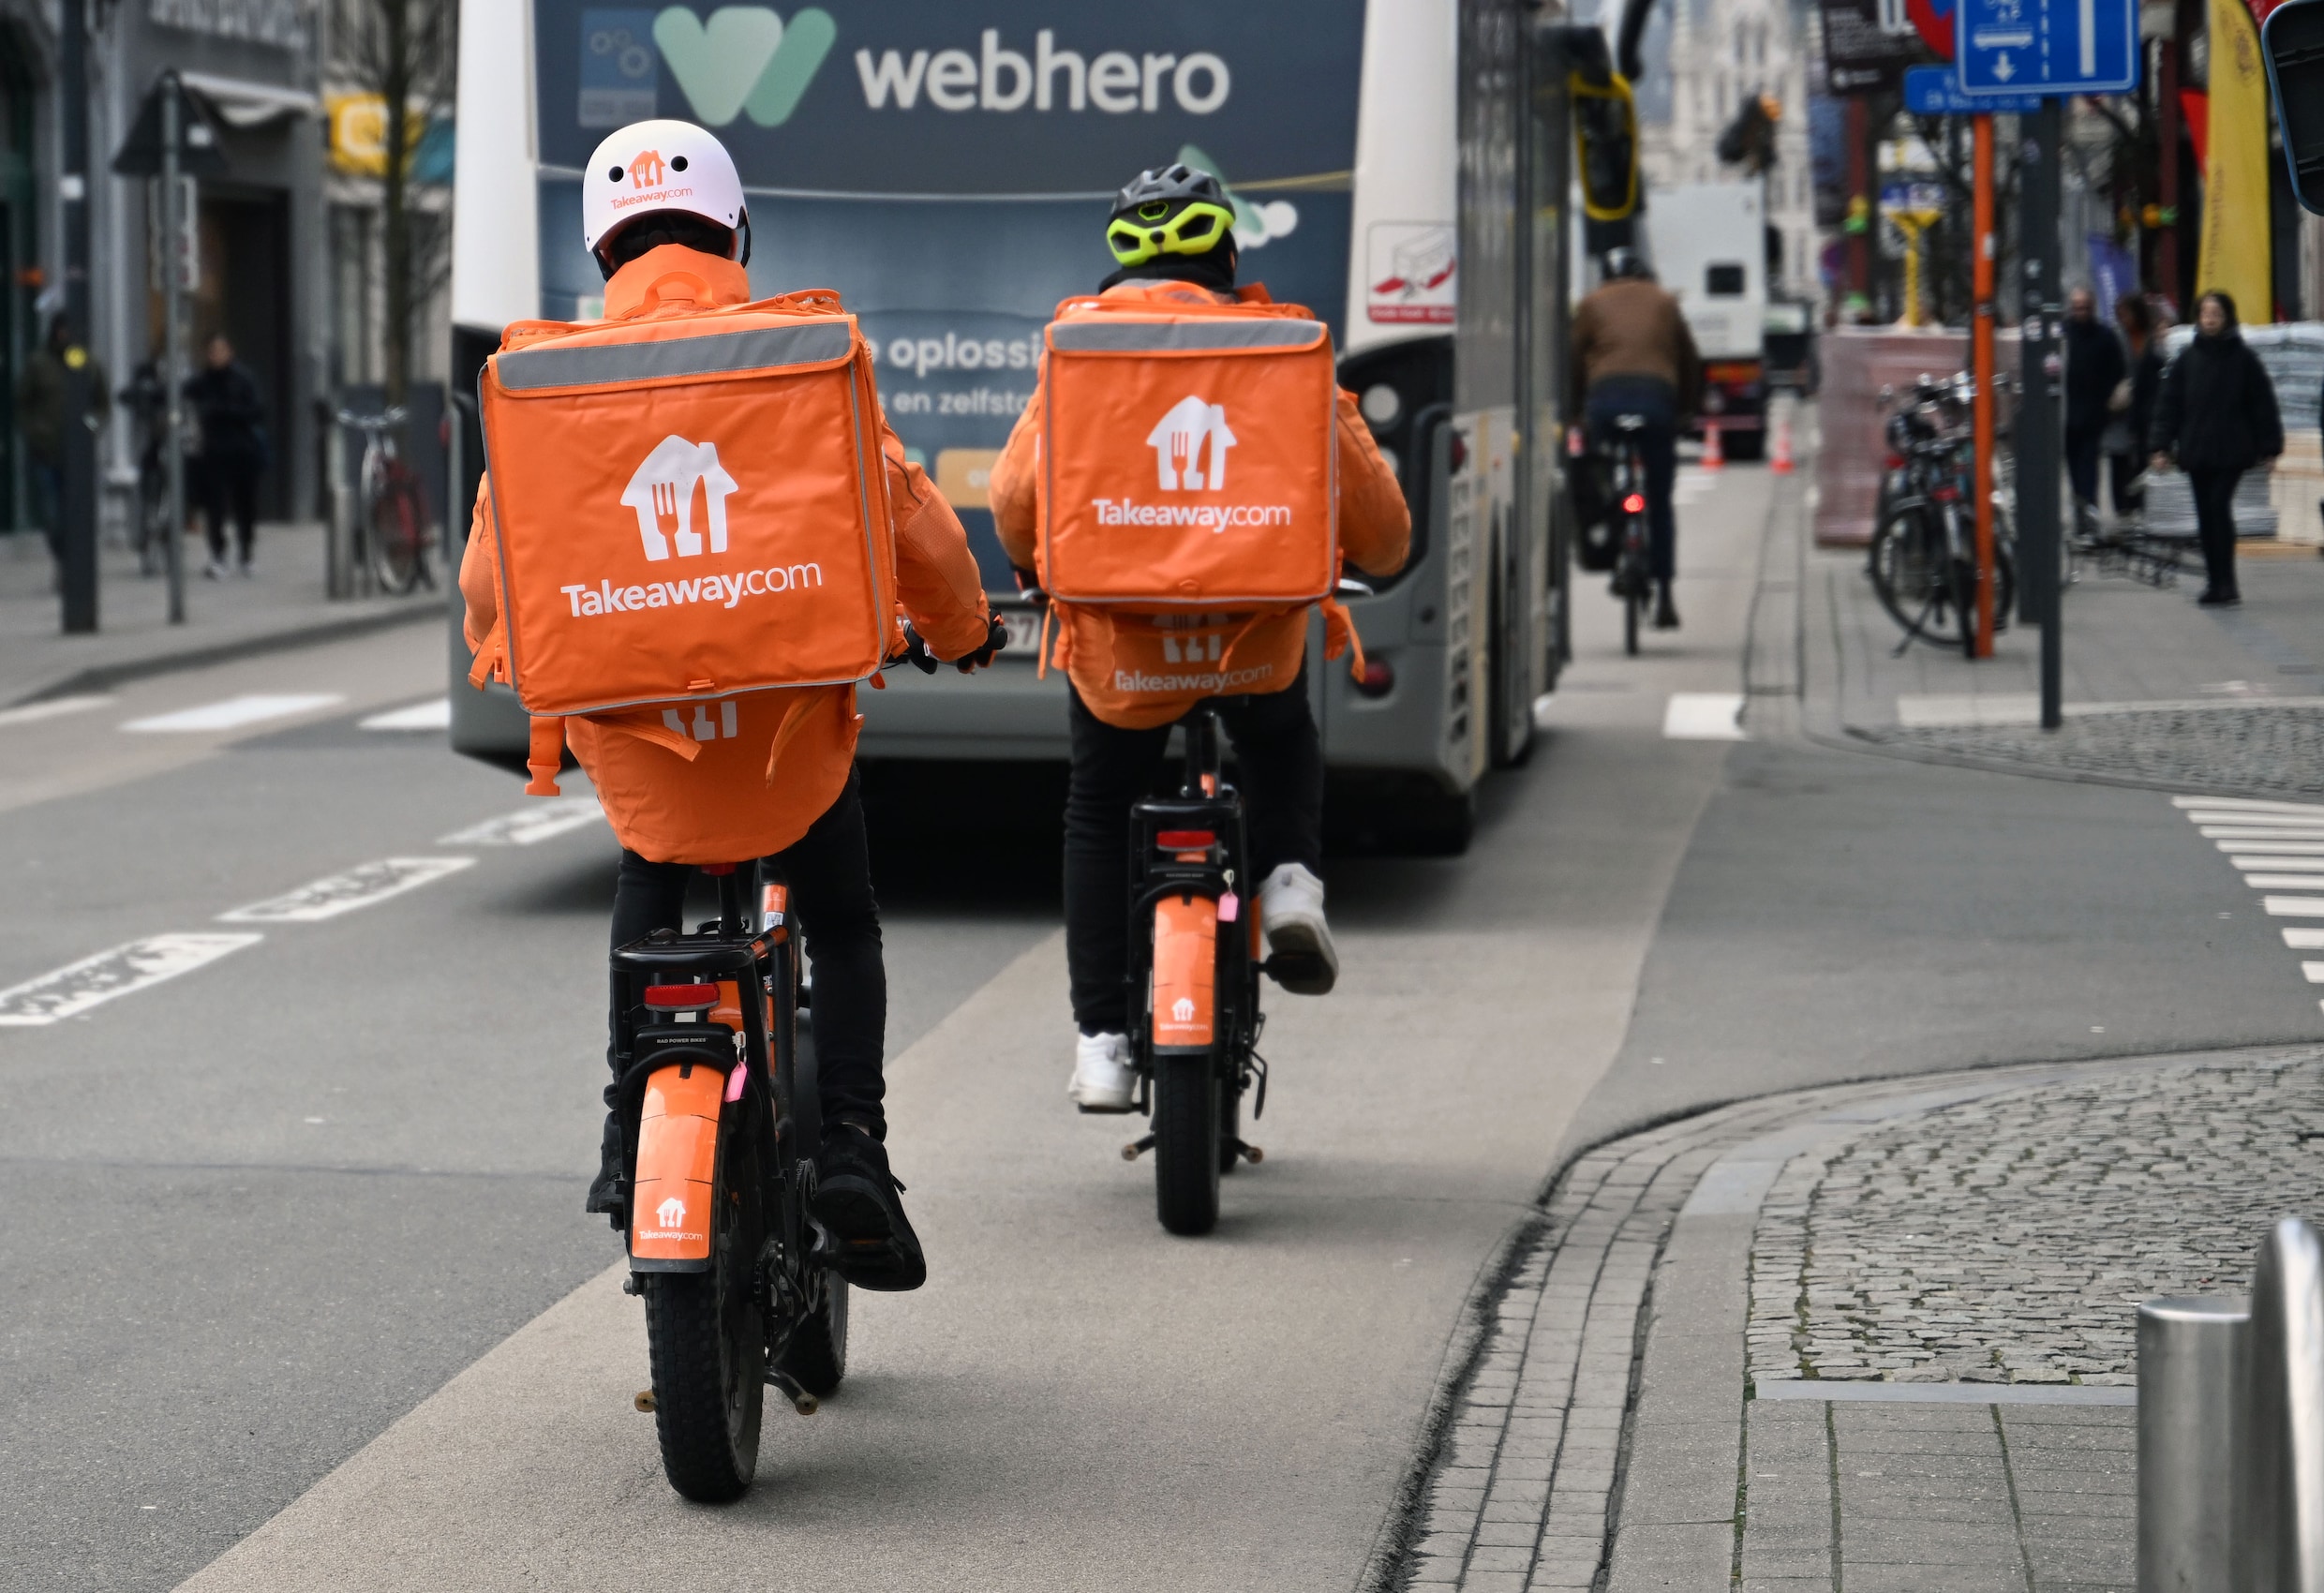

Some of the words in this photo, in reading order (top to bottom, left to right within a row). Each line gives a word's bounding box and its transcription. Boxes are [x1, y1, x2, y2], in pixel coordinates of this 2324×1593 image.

[855, 29, 1230, 112] webhero
[611, 188, 693, 209] Takeaway.com
[893, 393, 931, 412] en
[1092, 498, 1290, 533] Takeaway.com
[560, 562, 822, 618] Takeaway.com
[639, 1229, 703, 1242] Takeaway.com
